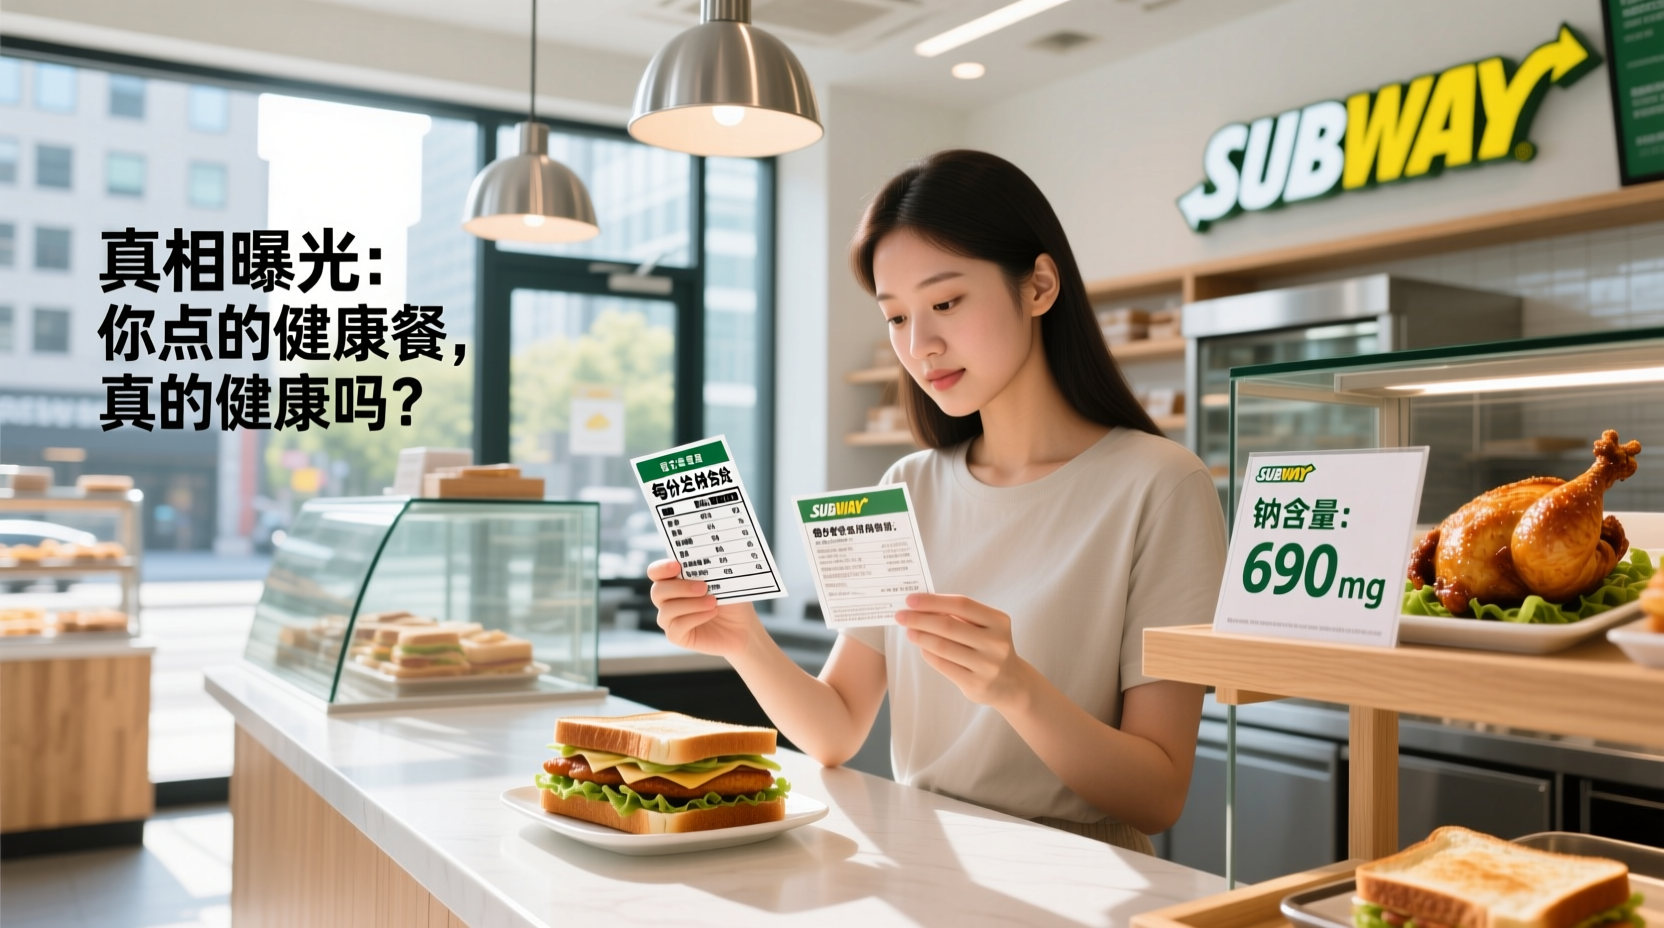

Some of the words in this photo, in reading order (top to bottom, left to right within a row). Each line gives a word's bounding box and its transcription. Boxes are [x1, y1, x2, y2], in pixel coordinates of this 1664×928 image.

[1177, 24, 1592, 231] SUBWAY
[1256, 464, 1316, 483] SUBWAY
[810, 497, 868, 518] SUBWAY
[1253, 497, 1351, 530] 钠含量：
[1242, 541, 1338, 598] 690
[1338, 576, 1386, 609] mg
